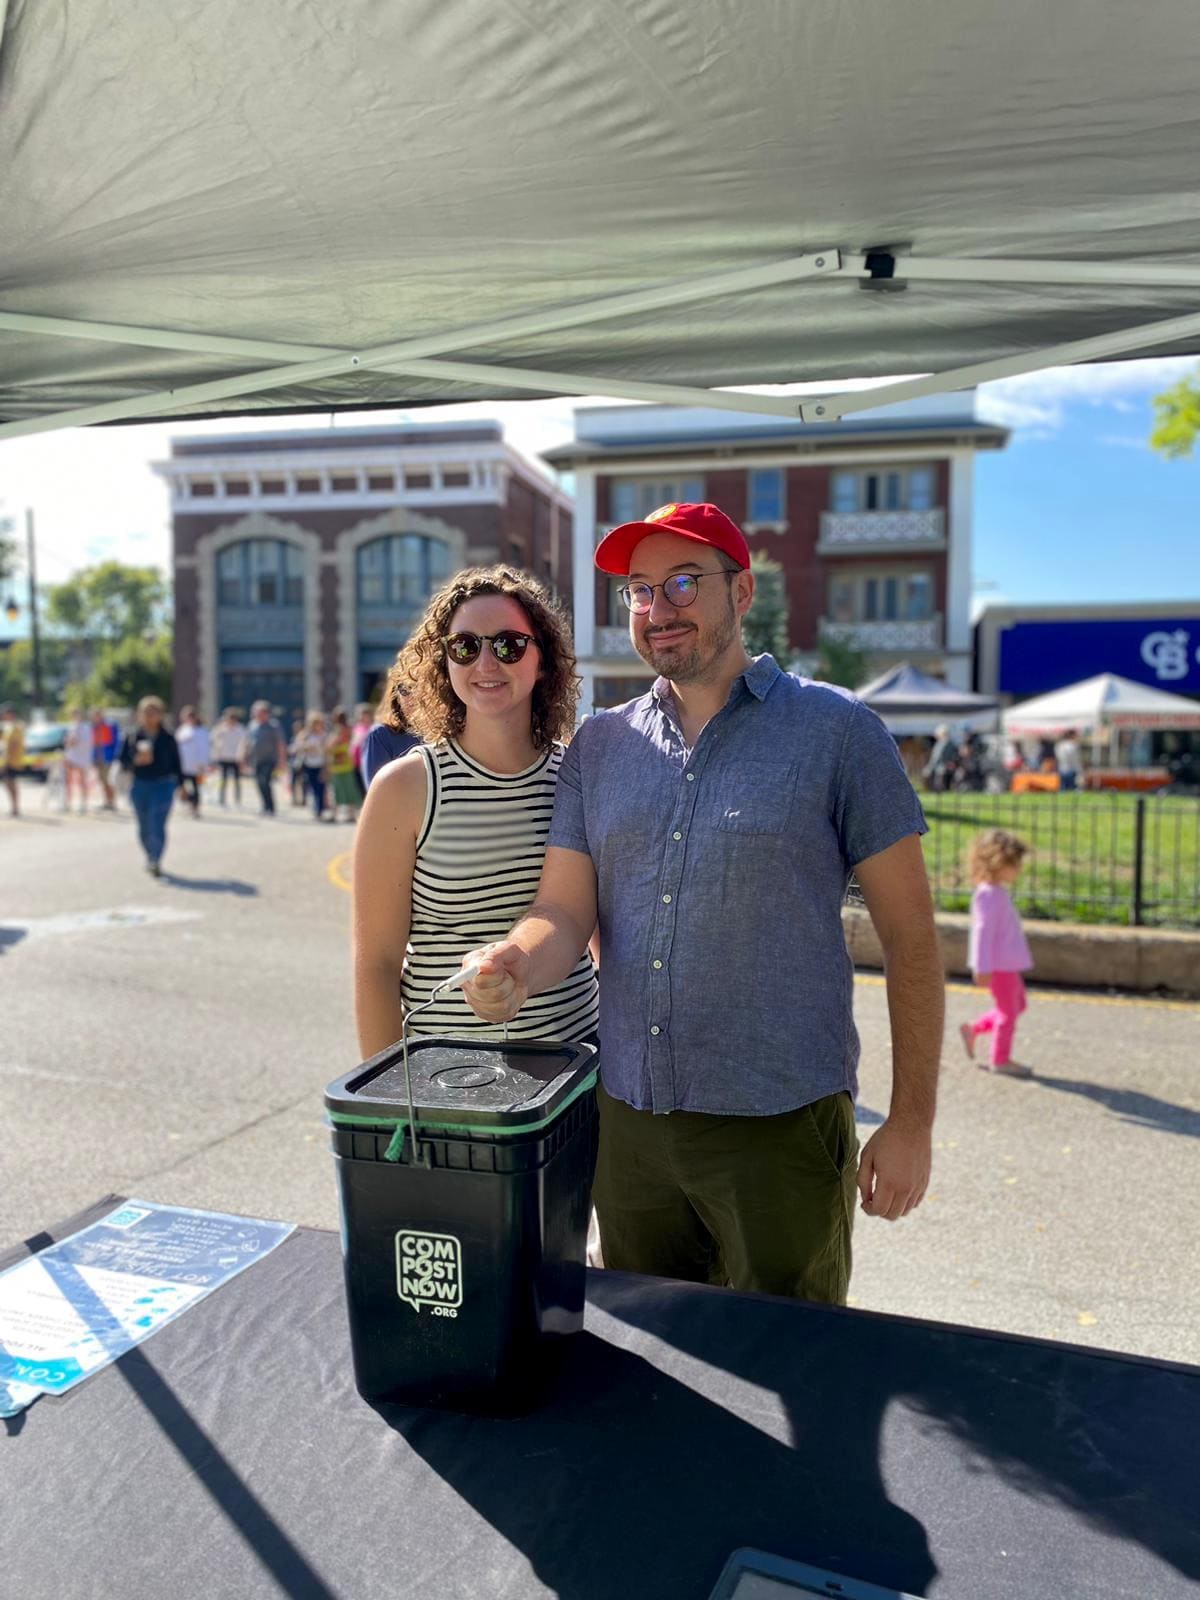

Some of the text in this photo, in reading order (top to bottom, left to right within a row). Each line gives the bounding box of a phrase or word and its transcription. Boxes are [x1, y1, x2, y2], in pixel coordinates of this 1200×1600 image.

[402, 1236, 455, 1260] COM
[402, 1256, 456, 1280] POST
[402, 1277, 457, 1300] NOW
[430, 1306, 458, 1318] .ORG
